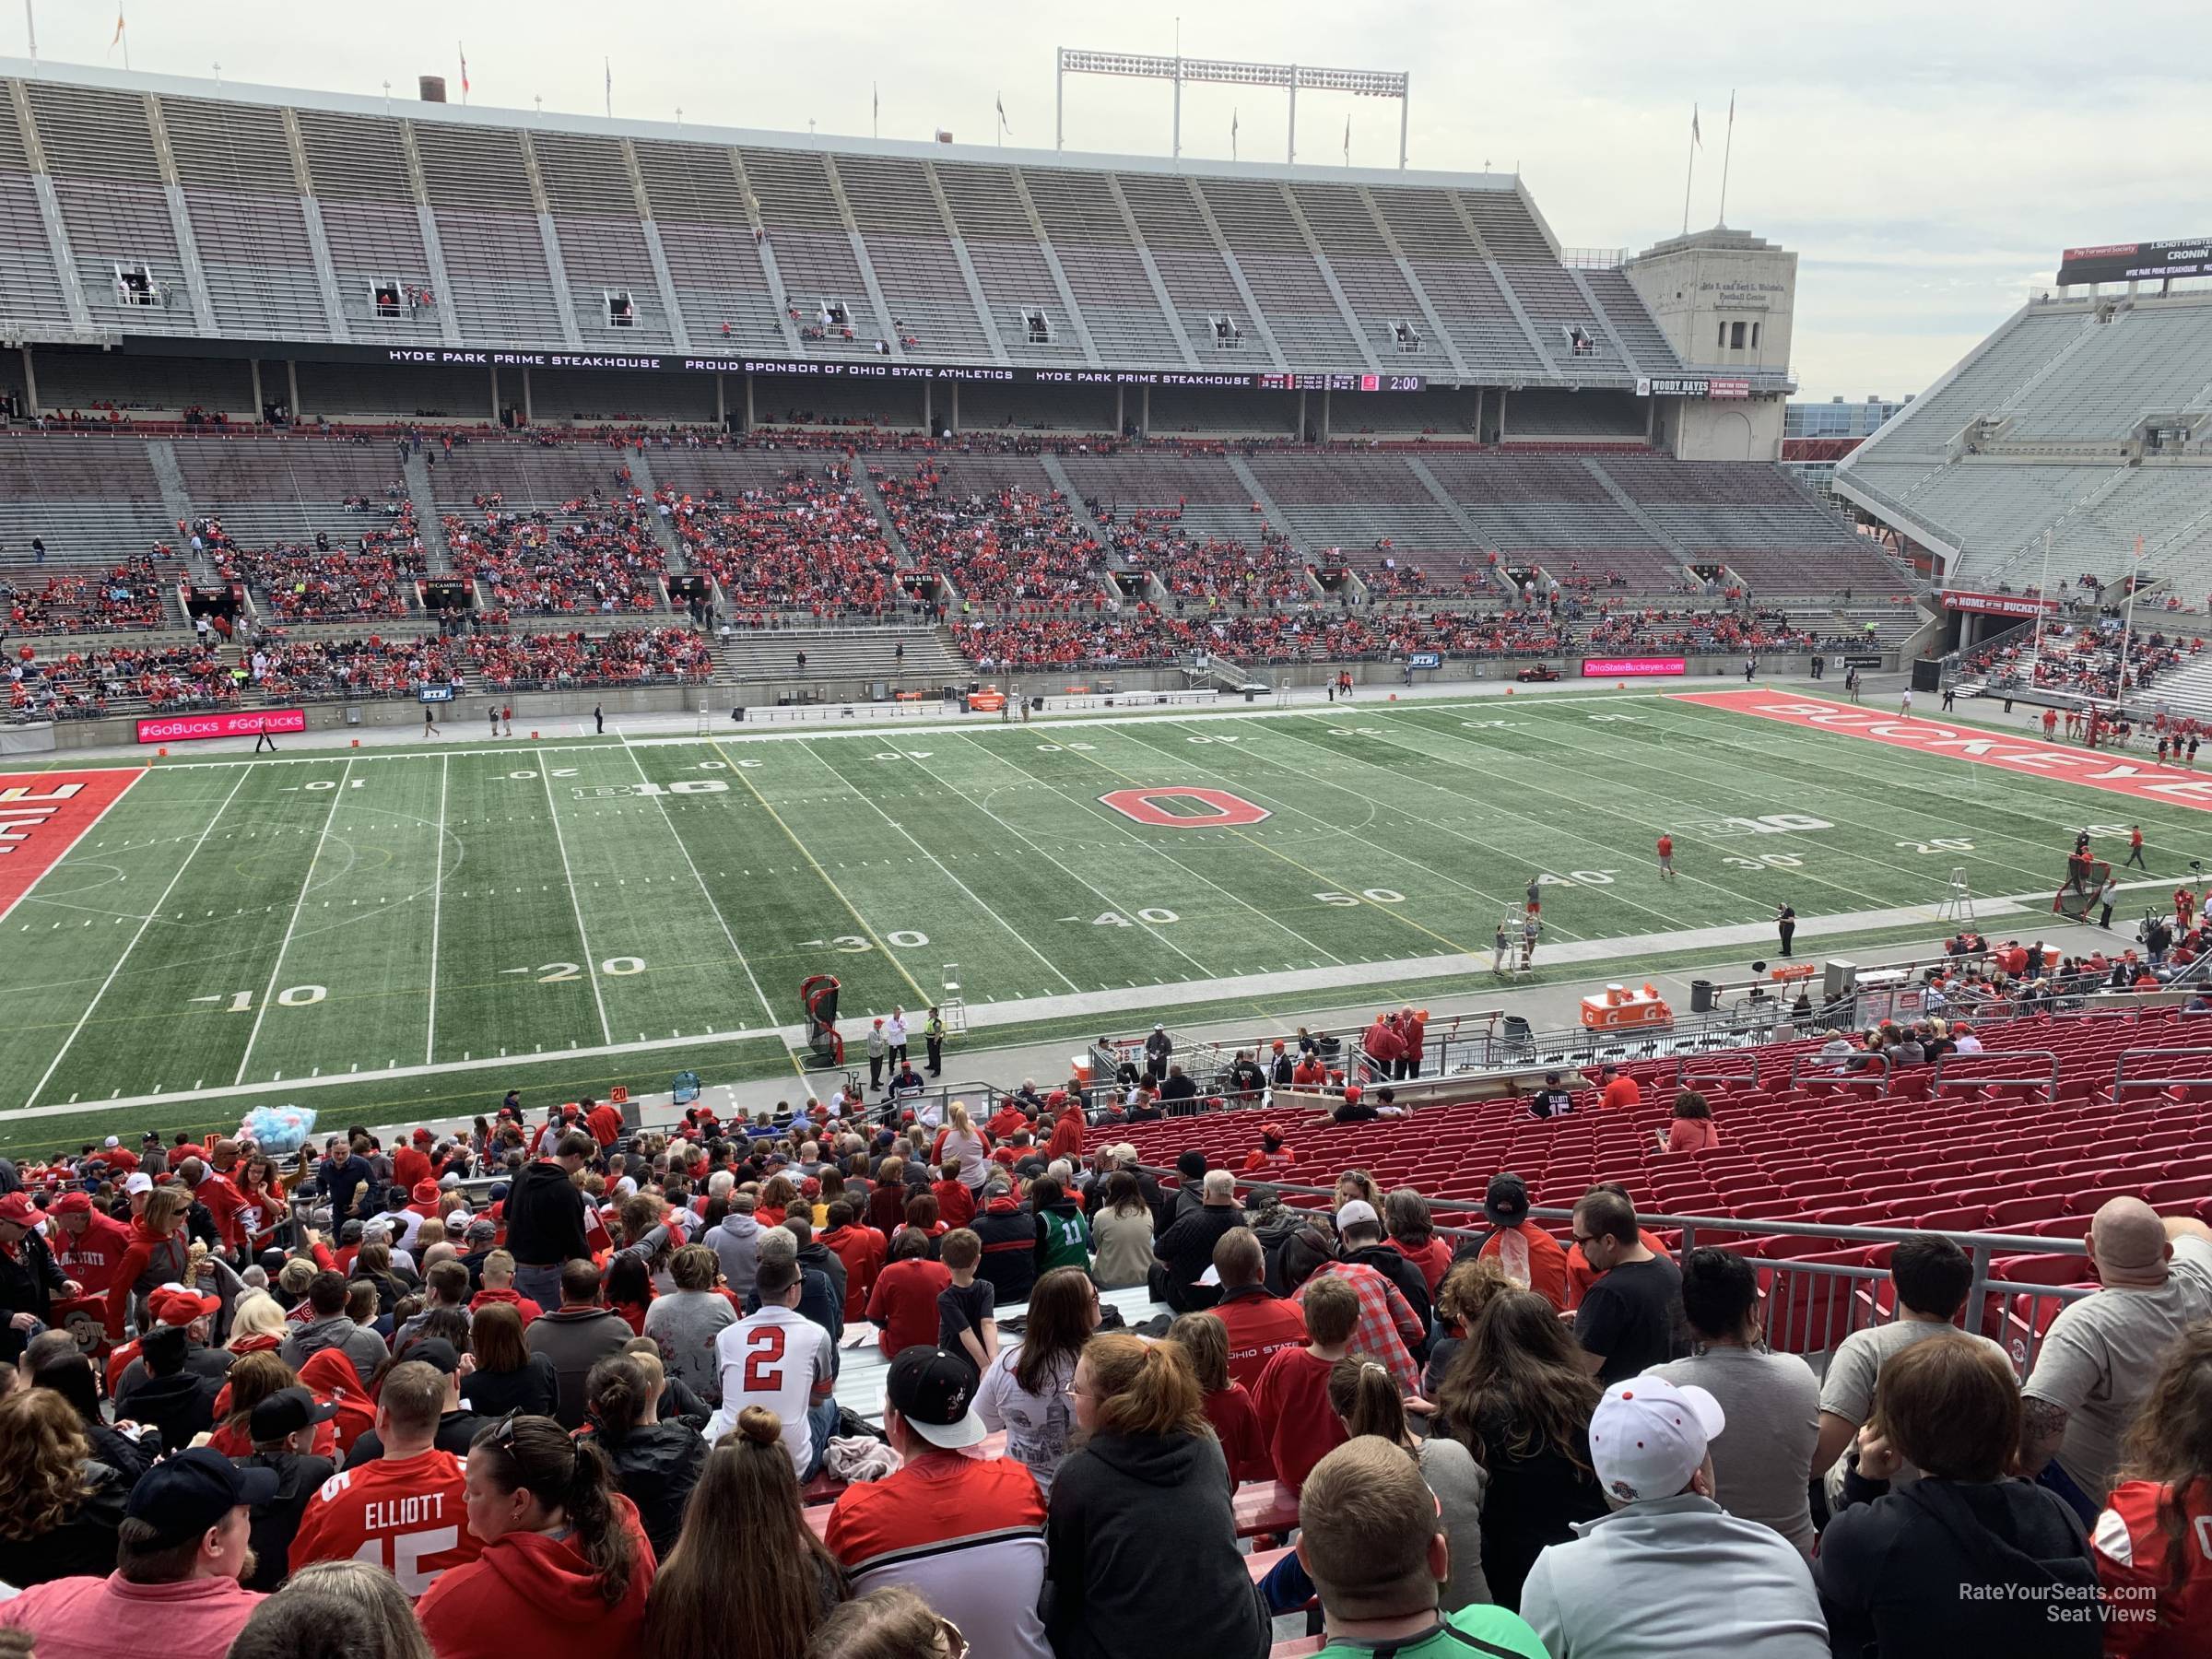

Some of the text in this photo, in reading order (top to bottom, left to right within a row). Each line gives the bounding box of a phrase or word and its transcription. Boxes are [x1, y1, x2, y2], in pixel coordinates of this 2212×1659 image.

[2168, 249, 2209, 260] CRONIN
[389, 351, 661, 368] HYDE PARK PRIME STEAKHOUSE
[686, 360, 1013, 380] PROUD SPONSOR OF OHIO STATE ATHLETICS
[1036, 372, 1251, 385] HYDE PARK PRIME STEAKHOUSE
[1391, 377, 1418, 390] 2:00
[1652, 381, 1709, 391] WOODY HAYES
[1959, 596, 1985, 608] HOME
[1412, 655, 1434, 665] BTN
[1585, 663, 1684, 674] OhioStateBuckeyes.com
[422, 689, 448, 700] BTN
[1312, 888, 1406, 907] 50
[1091, 908, 1180, 928] 40
[832, 930, 930, 953] 30
[537, 957, 646, 982] 20
[227, 984, 327, 1011] 10
[612, 1087, 626, 1100] 20
[1548, 1095, 1569, 1104] ELLIOTT
[1062, 1219, 1083, 1246] 11
[743, 1326, 785, 1392] 2
[1229, 1341, 1300, 1360] OHIO STATE
[365, 1492, 444, 1530] ELLIOTT
